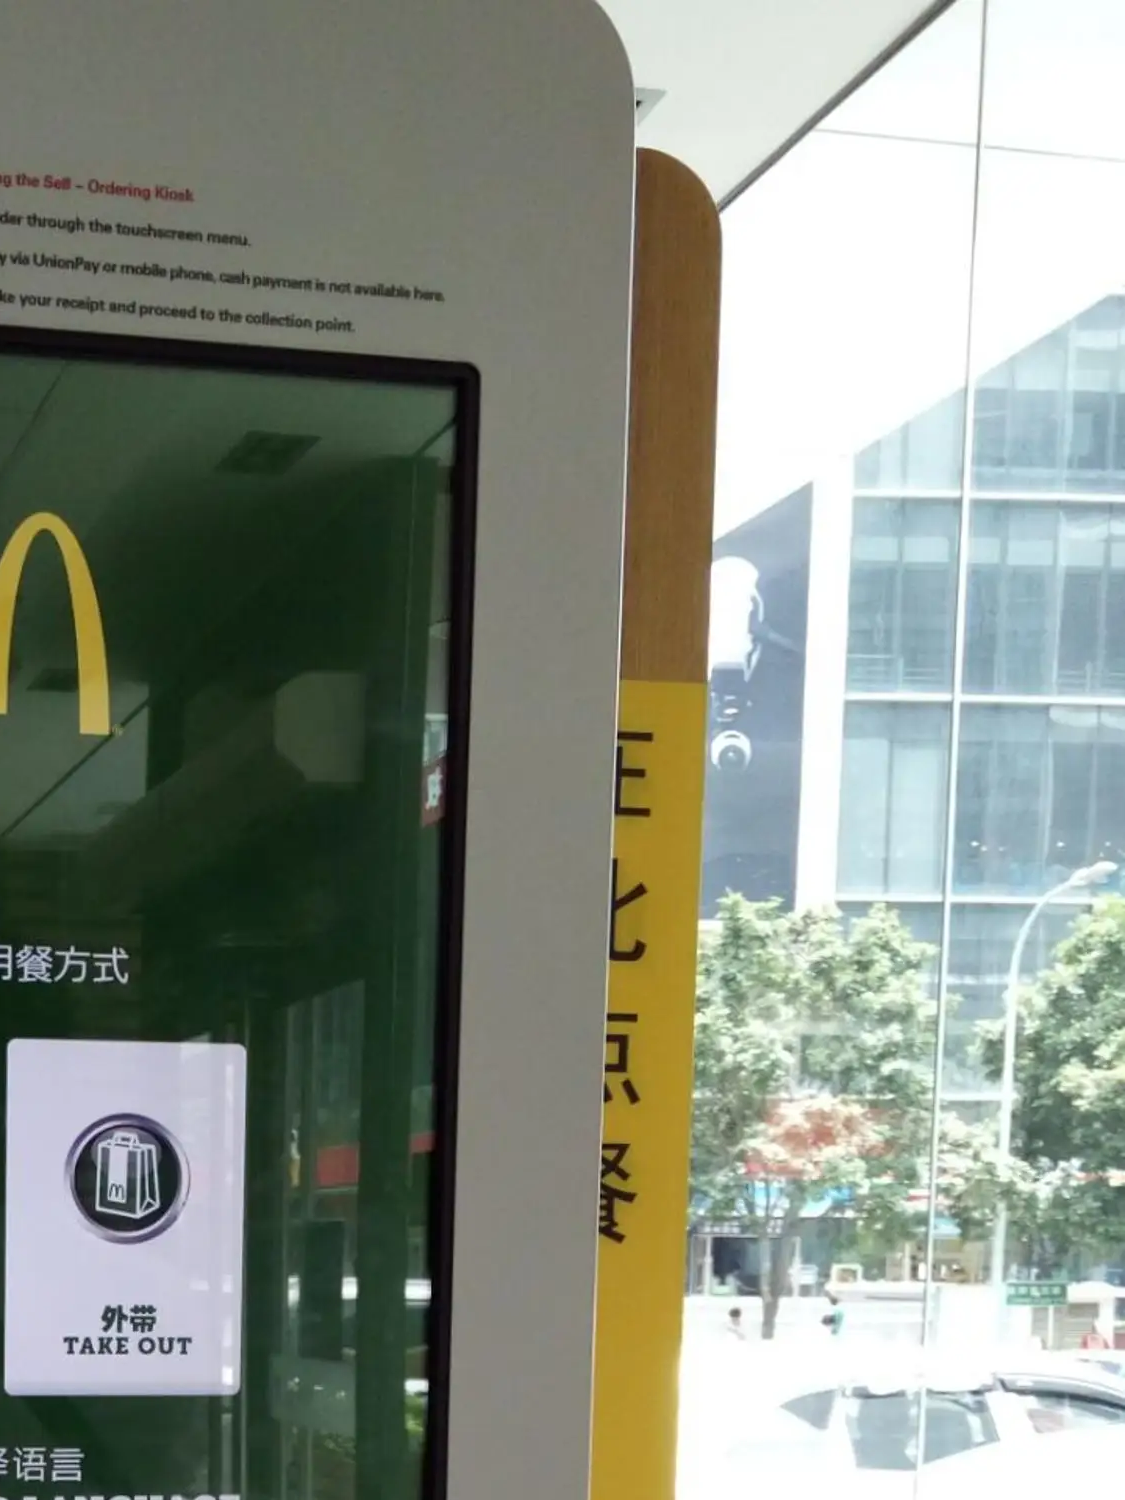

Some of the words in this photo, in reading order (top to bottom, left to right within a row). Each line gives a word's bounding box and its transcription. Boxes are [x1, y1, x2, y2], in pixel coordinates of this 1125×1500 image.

[16, 173, 40, 188] the
[87, 179, 151, 202] Ordering
[155, 185, 194, 202] Kiosk
[27, 213, 84, 233] through
[89, 218, 112, 234] the
[116, 222, 202, 242] touchscreen
[207, 231, 252, 247] menu.
[10, 251, 30, 266] via
[33, 252, 100, 274] UnionPay
[102, 262, 117, 274] or
[121, 261, 167, 277] mobile
[220, 270, 251, 285] cash
[253, 275, 313, 290] payment
[316, 278, 325, 291] is
[330, 282, 352, 294] not
[355, 283, 411, 299] available
[20, 293, 51, 310] your
[56, 296, 105, 313] receipt
[109, 301, 135, 313] and
[139, 304, 197, 320] proceed
[201, 307, 214, 320] to
[219, 309, 242, 323] the
[245, 311, 312, 329] collection
[316, 316, 355, 334] point.
[101, 1305, 156, 1334] 外带
[63, 1337, 129, 1356] TAKE
[138, 1337, 192, 1356] OUT
